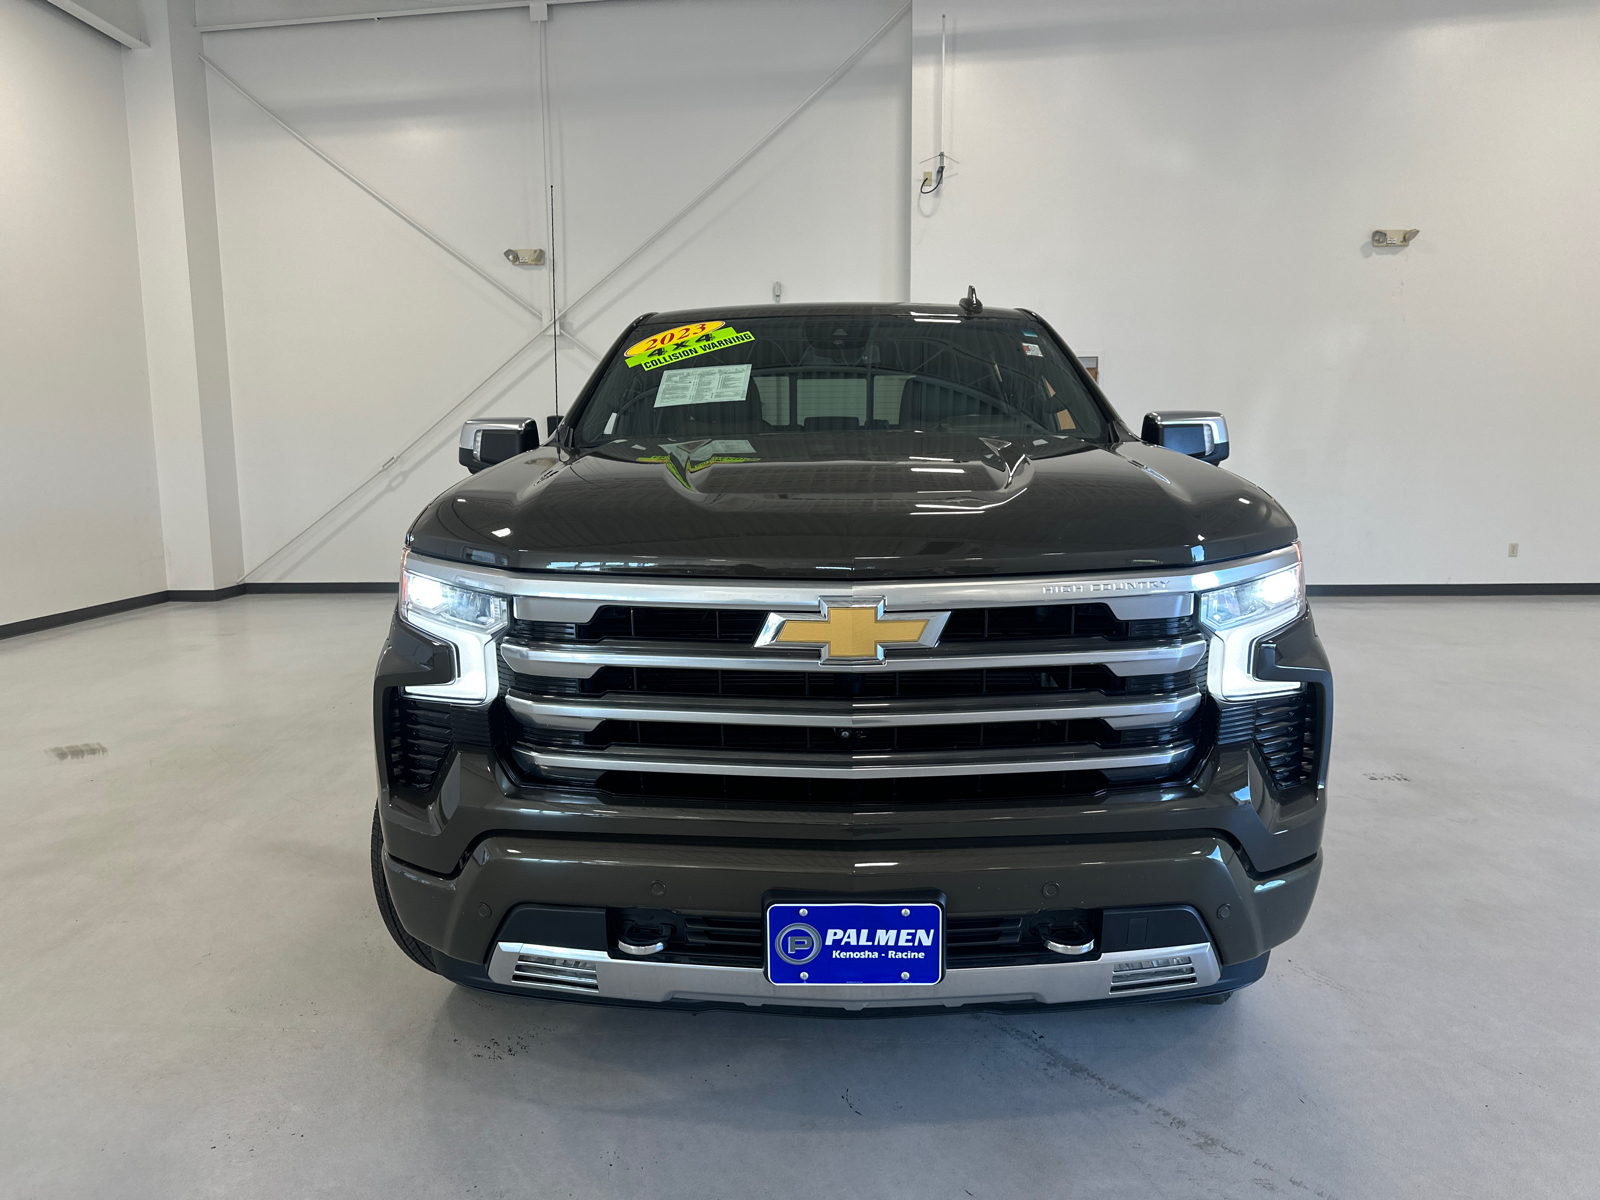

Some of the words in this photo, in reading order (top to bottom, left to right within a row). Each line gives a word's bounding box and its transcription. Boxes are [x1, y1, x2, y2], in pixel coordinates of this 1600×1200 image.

[645, 323, 706, 351] 2023
[647, 347, 668, 358] 4
[695, 333, 716, 343] 4
[643, 347, 699, 369] COLLISION
[700, 333, 752, 352] WARNING
[1042, 584, 1084, 594] HIGH
[1090, 580, 1170, 592] COUNTRY
[825, 929, 934, 946] PALMEN
[832, 950, 879, 959] Kenosha
[888, 951, 925, 959] Racine
